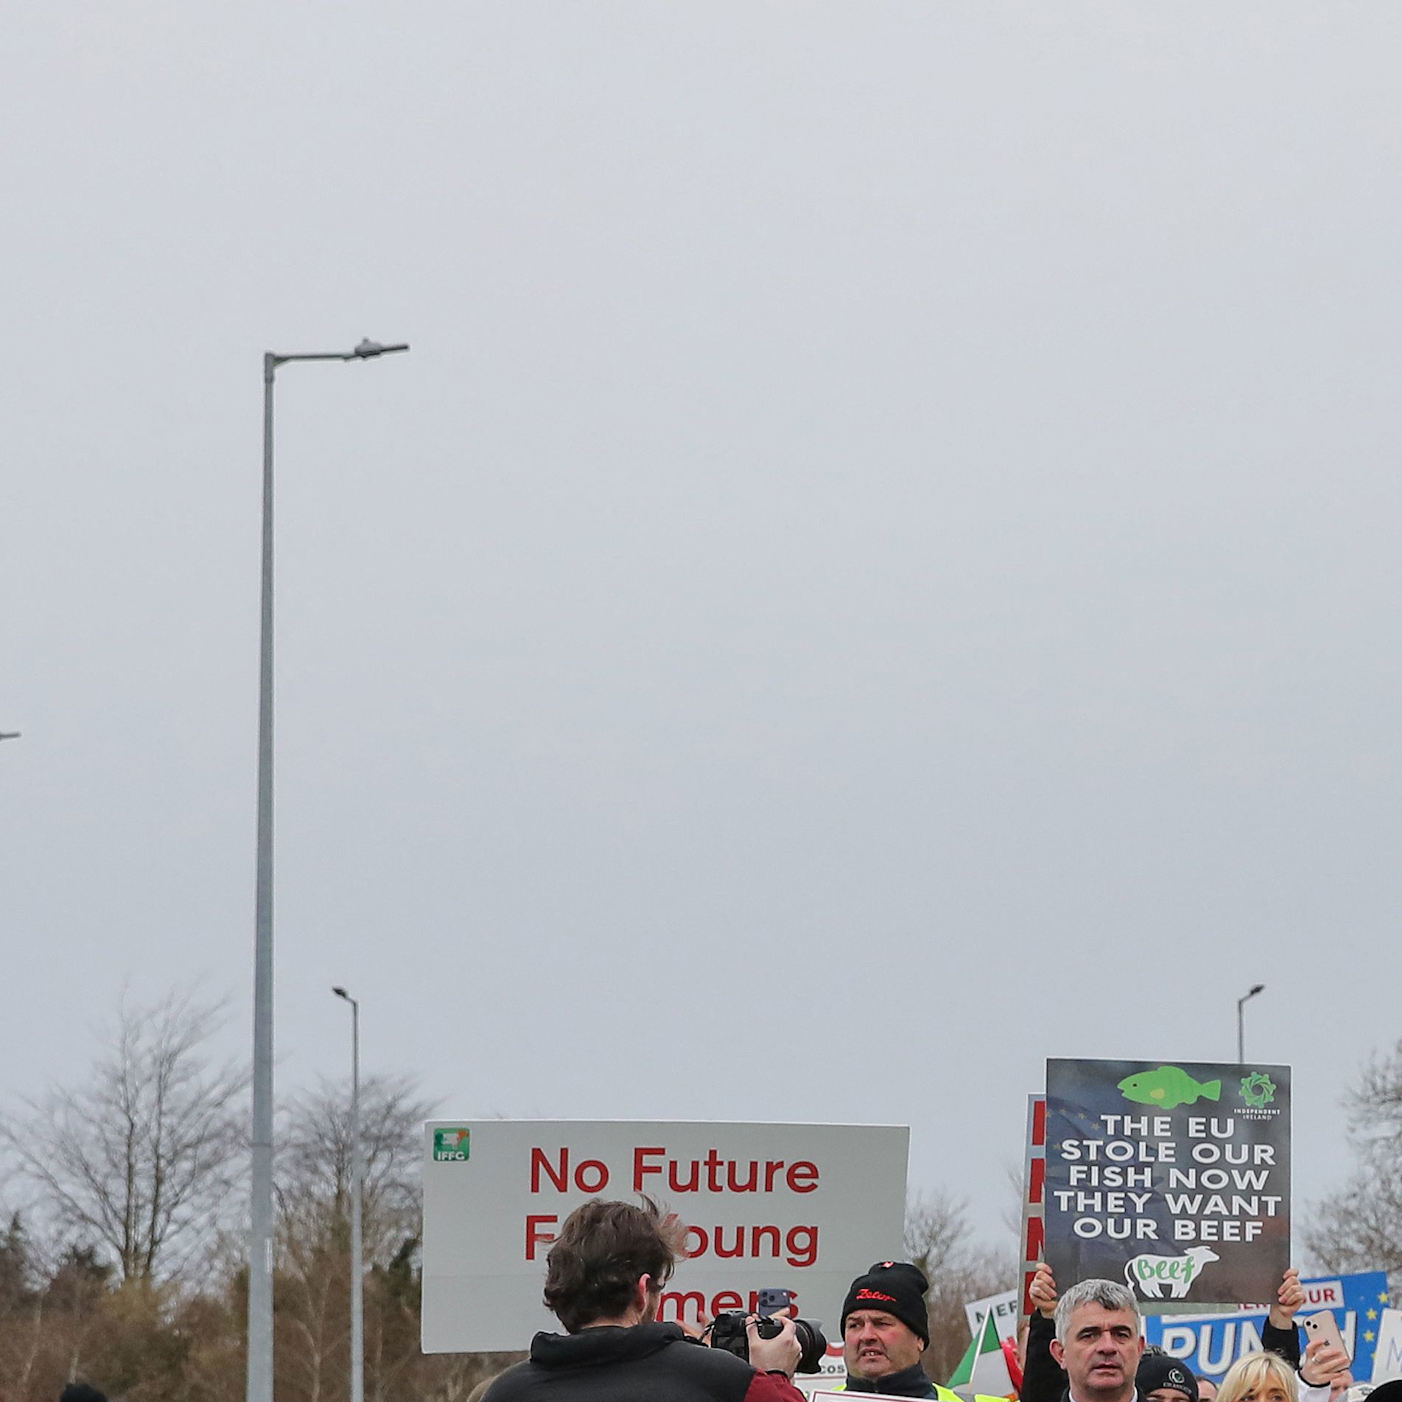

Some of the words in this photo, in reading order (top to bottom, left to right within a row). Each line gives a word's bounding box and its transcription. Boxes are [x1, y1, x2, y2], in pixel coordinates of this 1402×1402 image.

[1100, 1115, 1172, 1136] THE
[1188, 1117, 1235, 1139] EU
[1061, 1140, 1176, 1163] STOLE
[1192, 1143, 1276, 1165] OUR
[531, 1147, 610, 1194] No
[633, 1147, 819, 1194] Future
[1069, 1165, 1152, 1188] FISH
[1169, 1168, 1270, 1191] NOW
[1053, 1190, 1152, 1214] THEY
[1165, 1193, 1282, 1217] WANT
[662, 1213, 820, 1267] oung
[1073, 1217, 1159, 1240] OUR
[1174, 1220, 1263, 1242] BEEF
[1138, 1256, 1195, 1284] Beef
